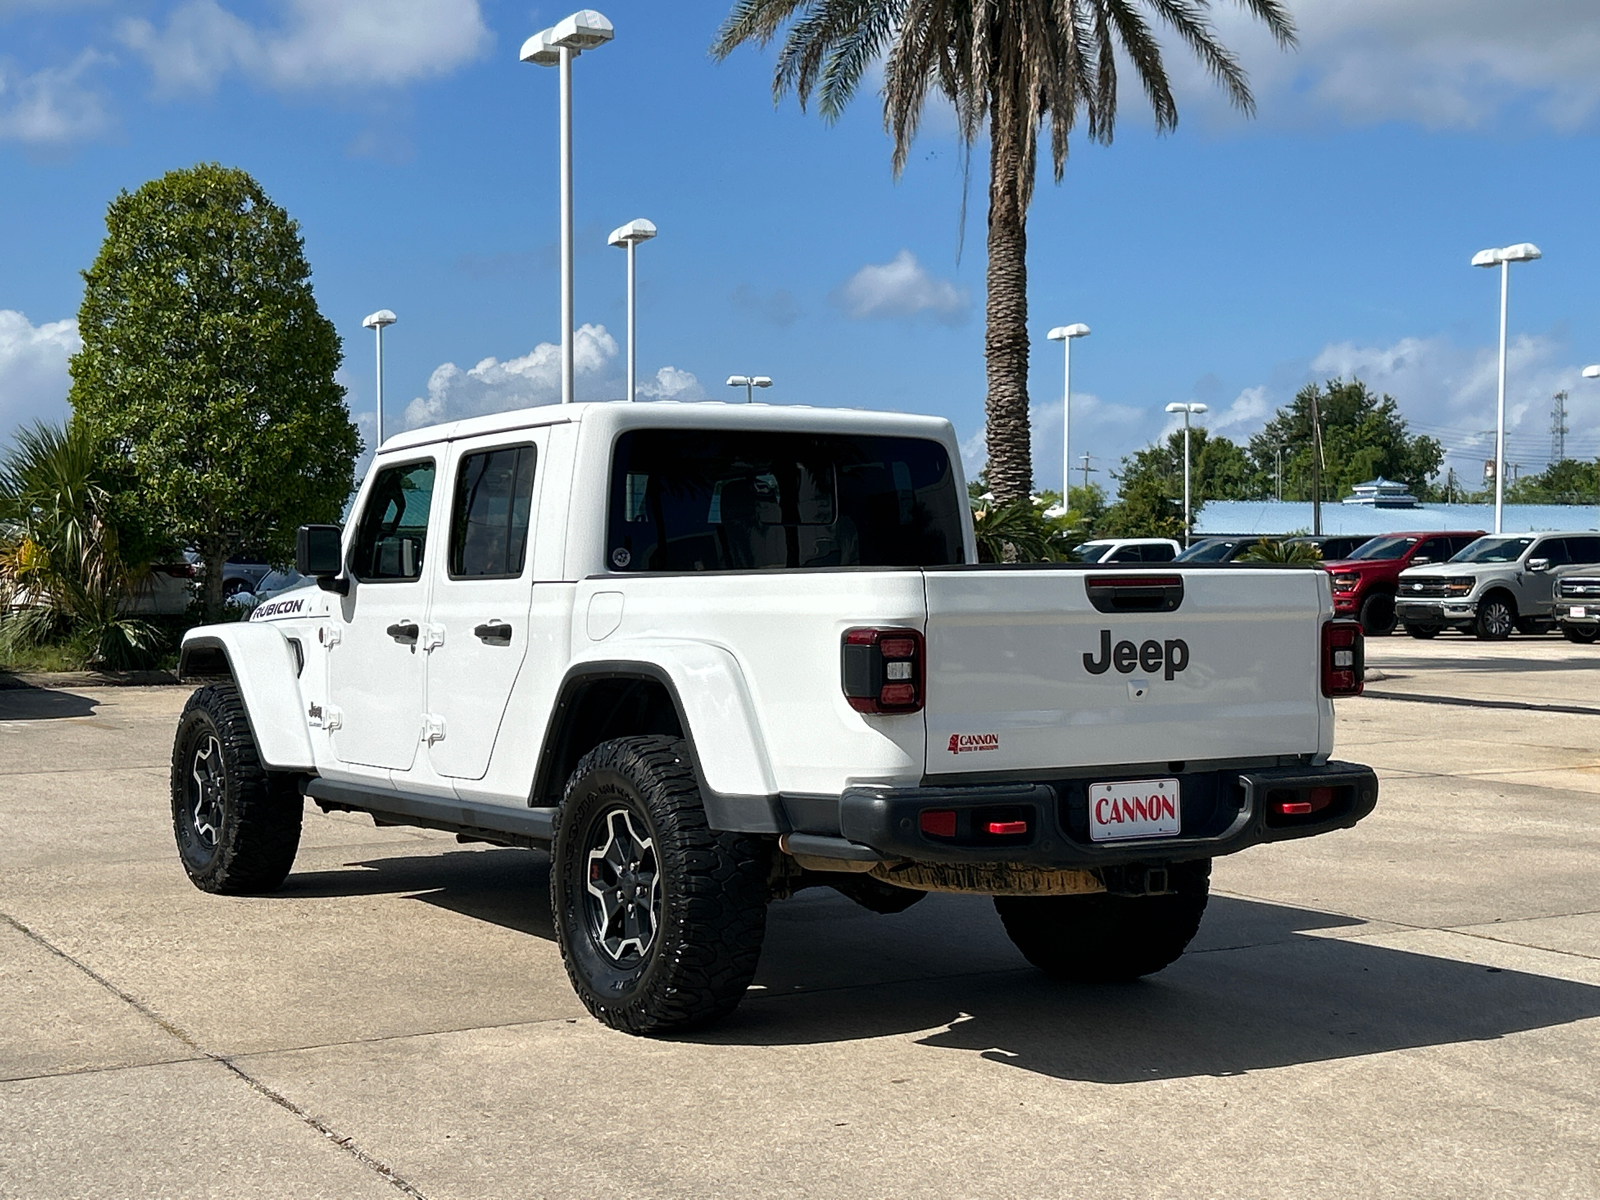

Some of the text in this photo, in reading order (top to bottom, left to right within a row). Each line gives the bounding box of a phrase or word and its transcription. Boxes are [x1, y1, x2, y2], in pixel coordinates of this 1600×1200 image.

[252, 599, 305, 620] RUBICON
[1083, 629, 1190, 681] Jeep
[959, 733, 999, 746] CANNON
[1095, 794, 1176, 825] CANNON
